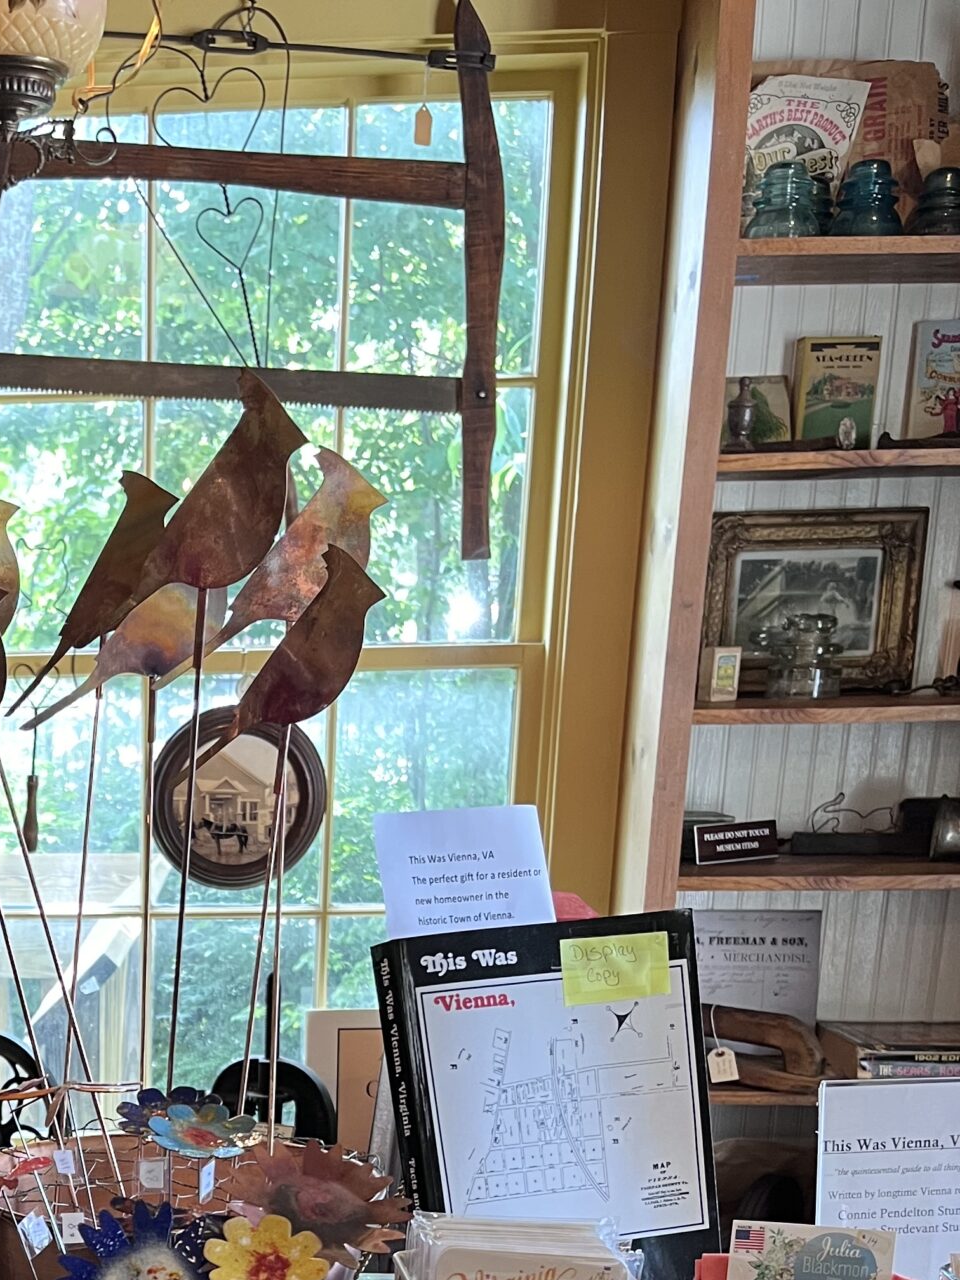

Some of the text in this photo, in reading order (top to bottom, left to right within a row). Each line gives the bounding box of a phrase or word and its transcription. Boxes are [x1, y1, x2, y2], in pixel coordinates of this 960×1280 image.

[786, 100, 820, 110] THE
[786, 108, 810, 122] BEST
[809, 112, 848, 146] PRODUCT
[703, 827, 770, 841] PLEASE DO NOT TOUCH
[715, 841, 759, 852] MUSEUM ITEMS
[408, 850, 495, 865] This Was Vienna, VA
[412, 876, 428, 886] The
[429, 874, 459, 887] perfect
[460, 872, 475, 885] gift
[476, 871, 489, 882] for
[497, 869, 532, 880] resident
[415, 891, 510, 906] new homeowner in the
[418, 911, 516, 927] historic Town of Vienna.
[708, 937, 767, 946] FREEMAN
[770, 937, 778, 946] &
[569, 943, 640, 964] Display
[419, 948, 519, 977] This Was
[586, 967, 621, 987] Copy
[433, 993, 517, 1013] Vienna,
[941, 1053, 960, 1062] EDI
[379, 957, 391, 987] This
[386, 989, 395, 1021] Was
[400, 1081, 412, 1138] Virginia
[408, 1157, 419, 1191] Facts
[879, 1064, 894, 1076] THE
[938, 1065, 960, 1077] ROE
[824, 1136, 946, 1153] This Was Vienna,
[652, 1161, 672, 1170] MAP
[901, 1164, 923, 1176] guide
[923, 1165, 931, 1173] to
[932, 1163, 943, 1173] all
[828, 1186, 953, 1200] Written by longtime Vienna
[838, 1205, 960, 1221] Connie Pendelton Stur
[880, 1221, 960, 1236] Sturdevant Stu
[816, 1236, 862, 1262] Julia
[802, 1256, 869, 1278] Blackmon
